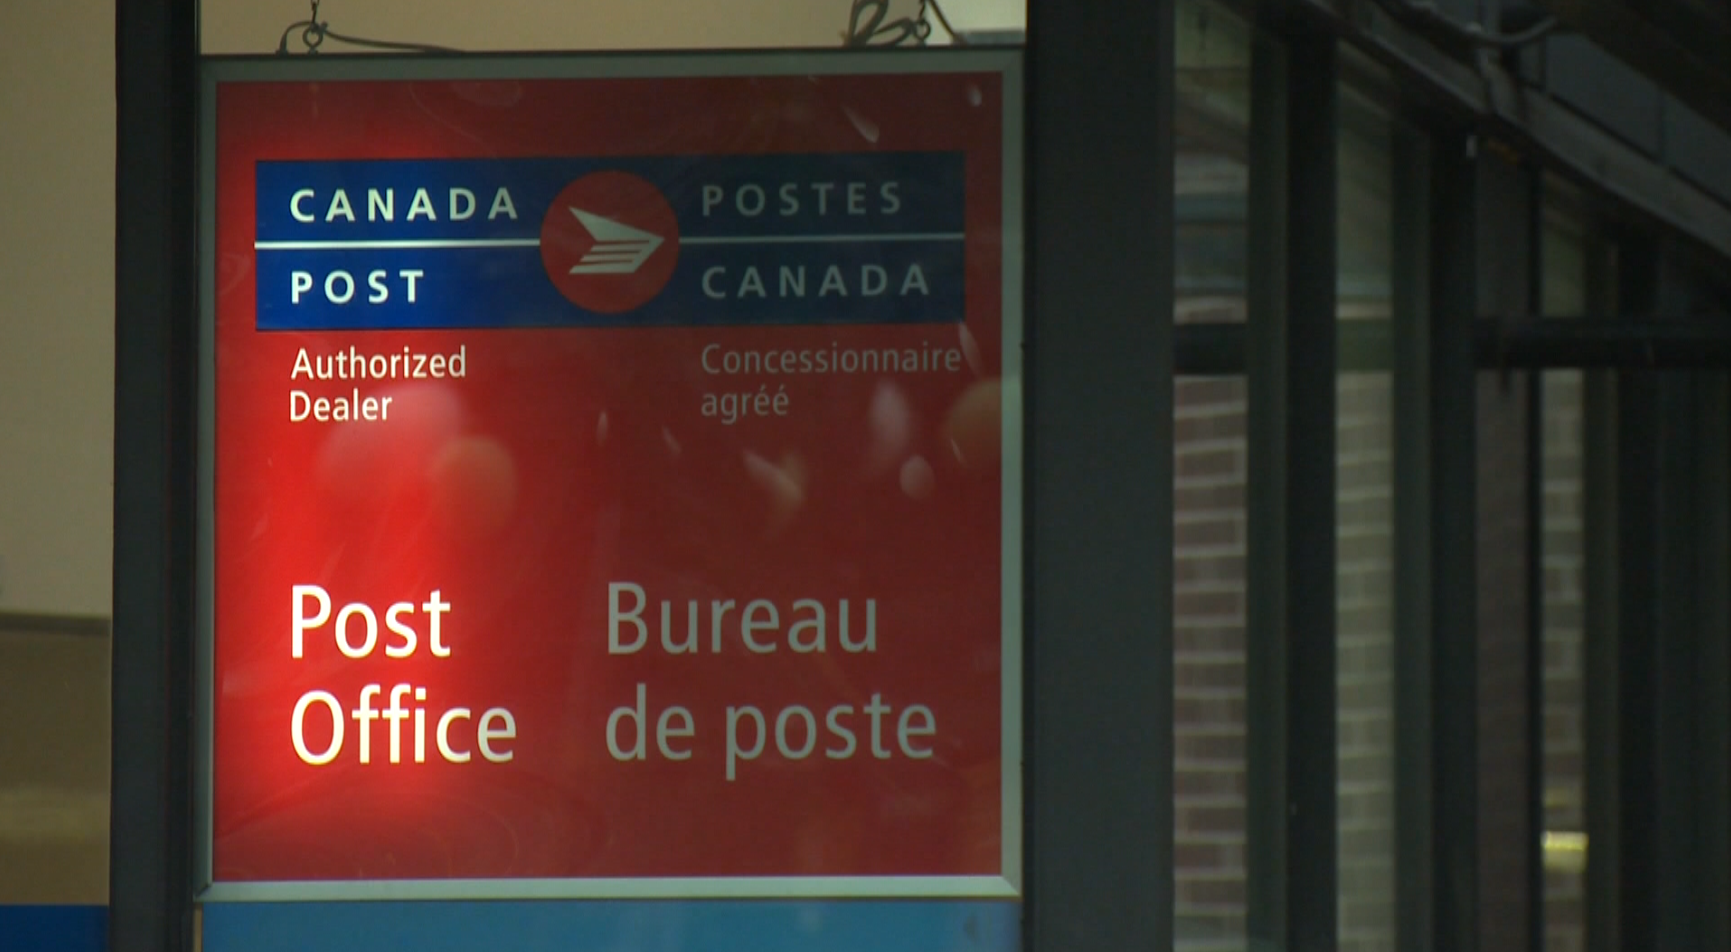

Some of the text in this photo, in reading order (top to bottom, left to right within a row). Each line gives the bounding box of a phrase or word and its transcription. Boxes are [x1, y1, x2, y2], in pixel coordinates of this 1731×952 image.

[290, 187, 518, 222] CANADA
[702, 182, 902, 216] POSTES
[291, 269, 424, 304] POST
[702, 264, 930, 299] CANADA
[290, 346, 467, 380] Authorized
[701, 341, 963, 375] Concessionnaire
[289, 389, 394, 423] Dealer
[701, 384, 790, 424] agréé
[291, 584, 452, 659] Post
[608, 582, 877, 654] Bureau
[291, 683, 517, 765] Office
[605, 683, 937, 781] de poste
